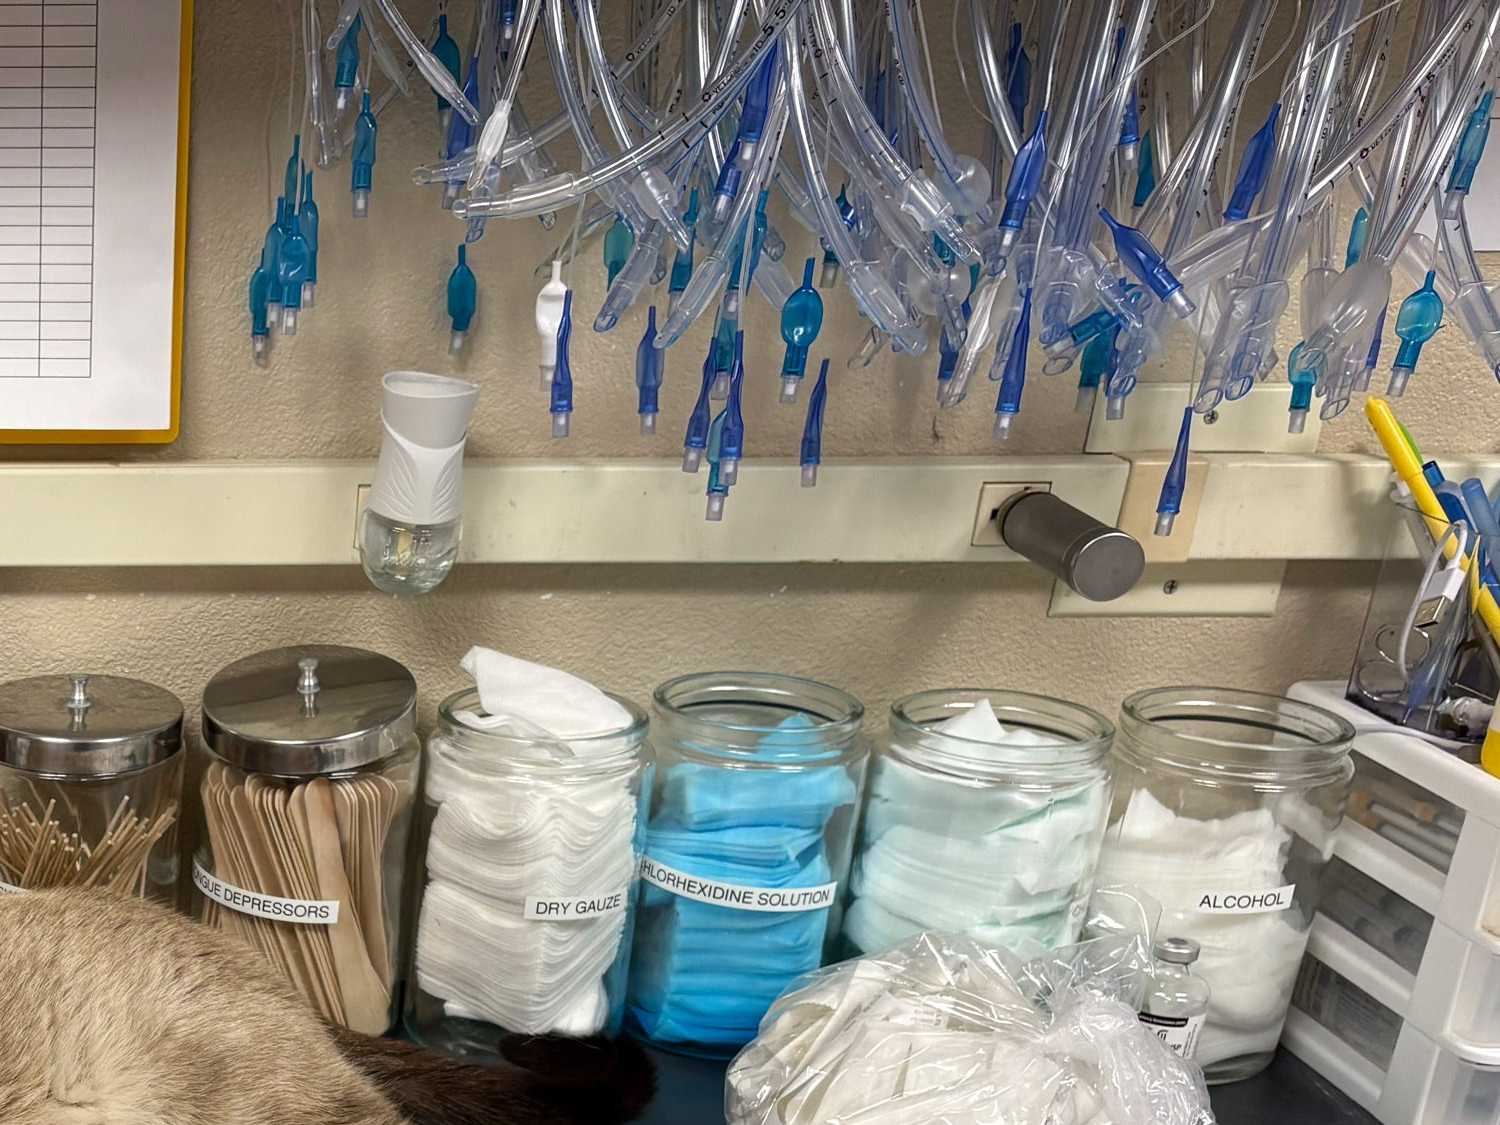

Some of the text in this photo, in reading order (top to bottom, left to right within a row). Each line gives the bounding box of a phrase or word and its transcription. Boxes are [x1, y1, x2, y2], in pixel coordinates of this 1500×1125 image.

[763, 6, 786, 37] 5.5
[641, 859, 829, 906] HLORHEXIDINE SOLUTION
[224, 888, 330, 919] DEPRESSORS
[536, 894, 621, 915] DRY GAUZE
[1199, 893, 1284, 908] ALCOHOL
